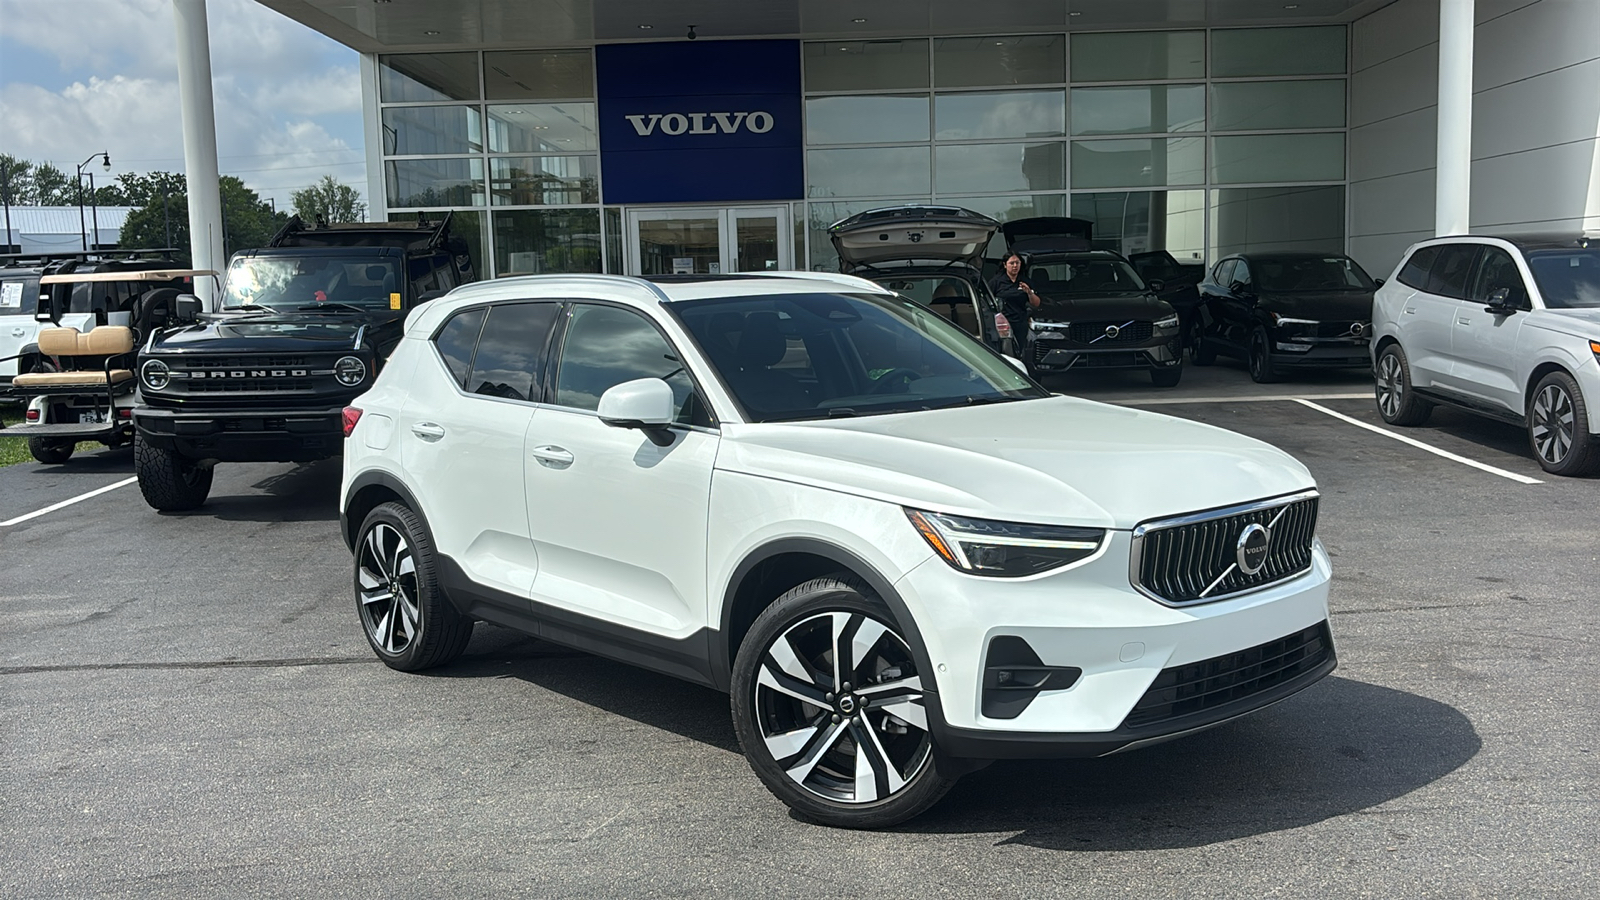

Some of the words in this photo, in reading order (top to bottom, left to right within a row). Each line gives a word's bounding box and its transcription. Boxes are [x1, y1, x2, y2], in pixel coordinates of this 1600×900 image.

[625, 111, 774, 136] VOLVO
[191, 370, 307, 378] BRONCO
[1246, 545, 1267, 555] VOLVO
